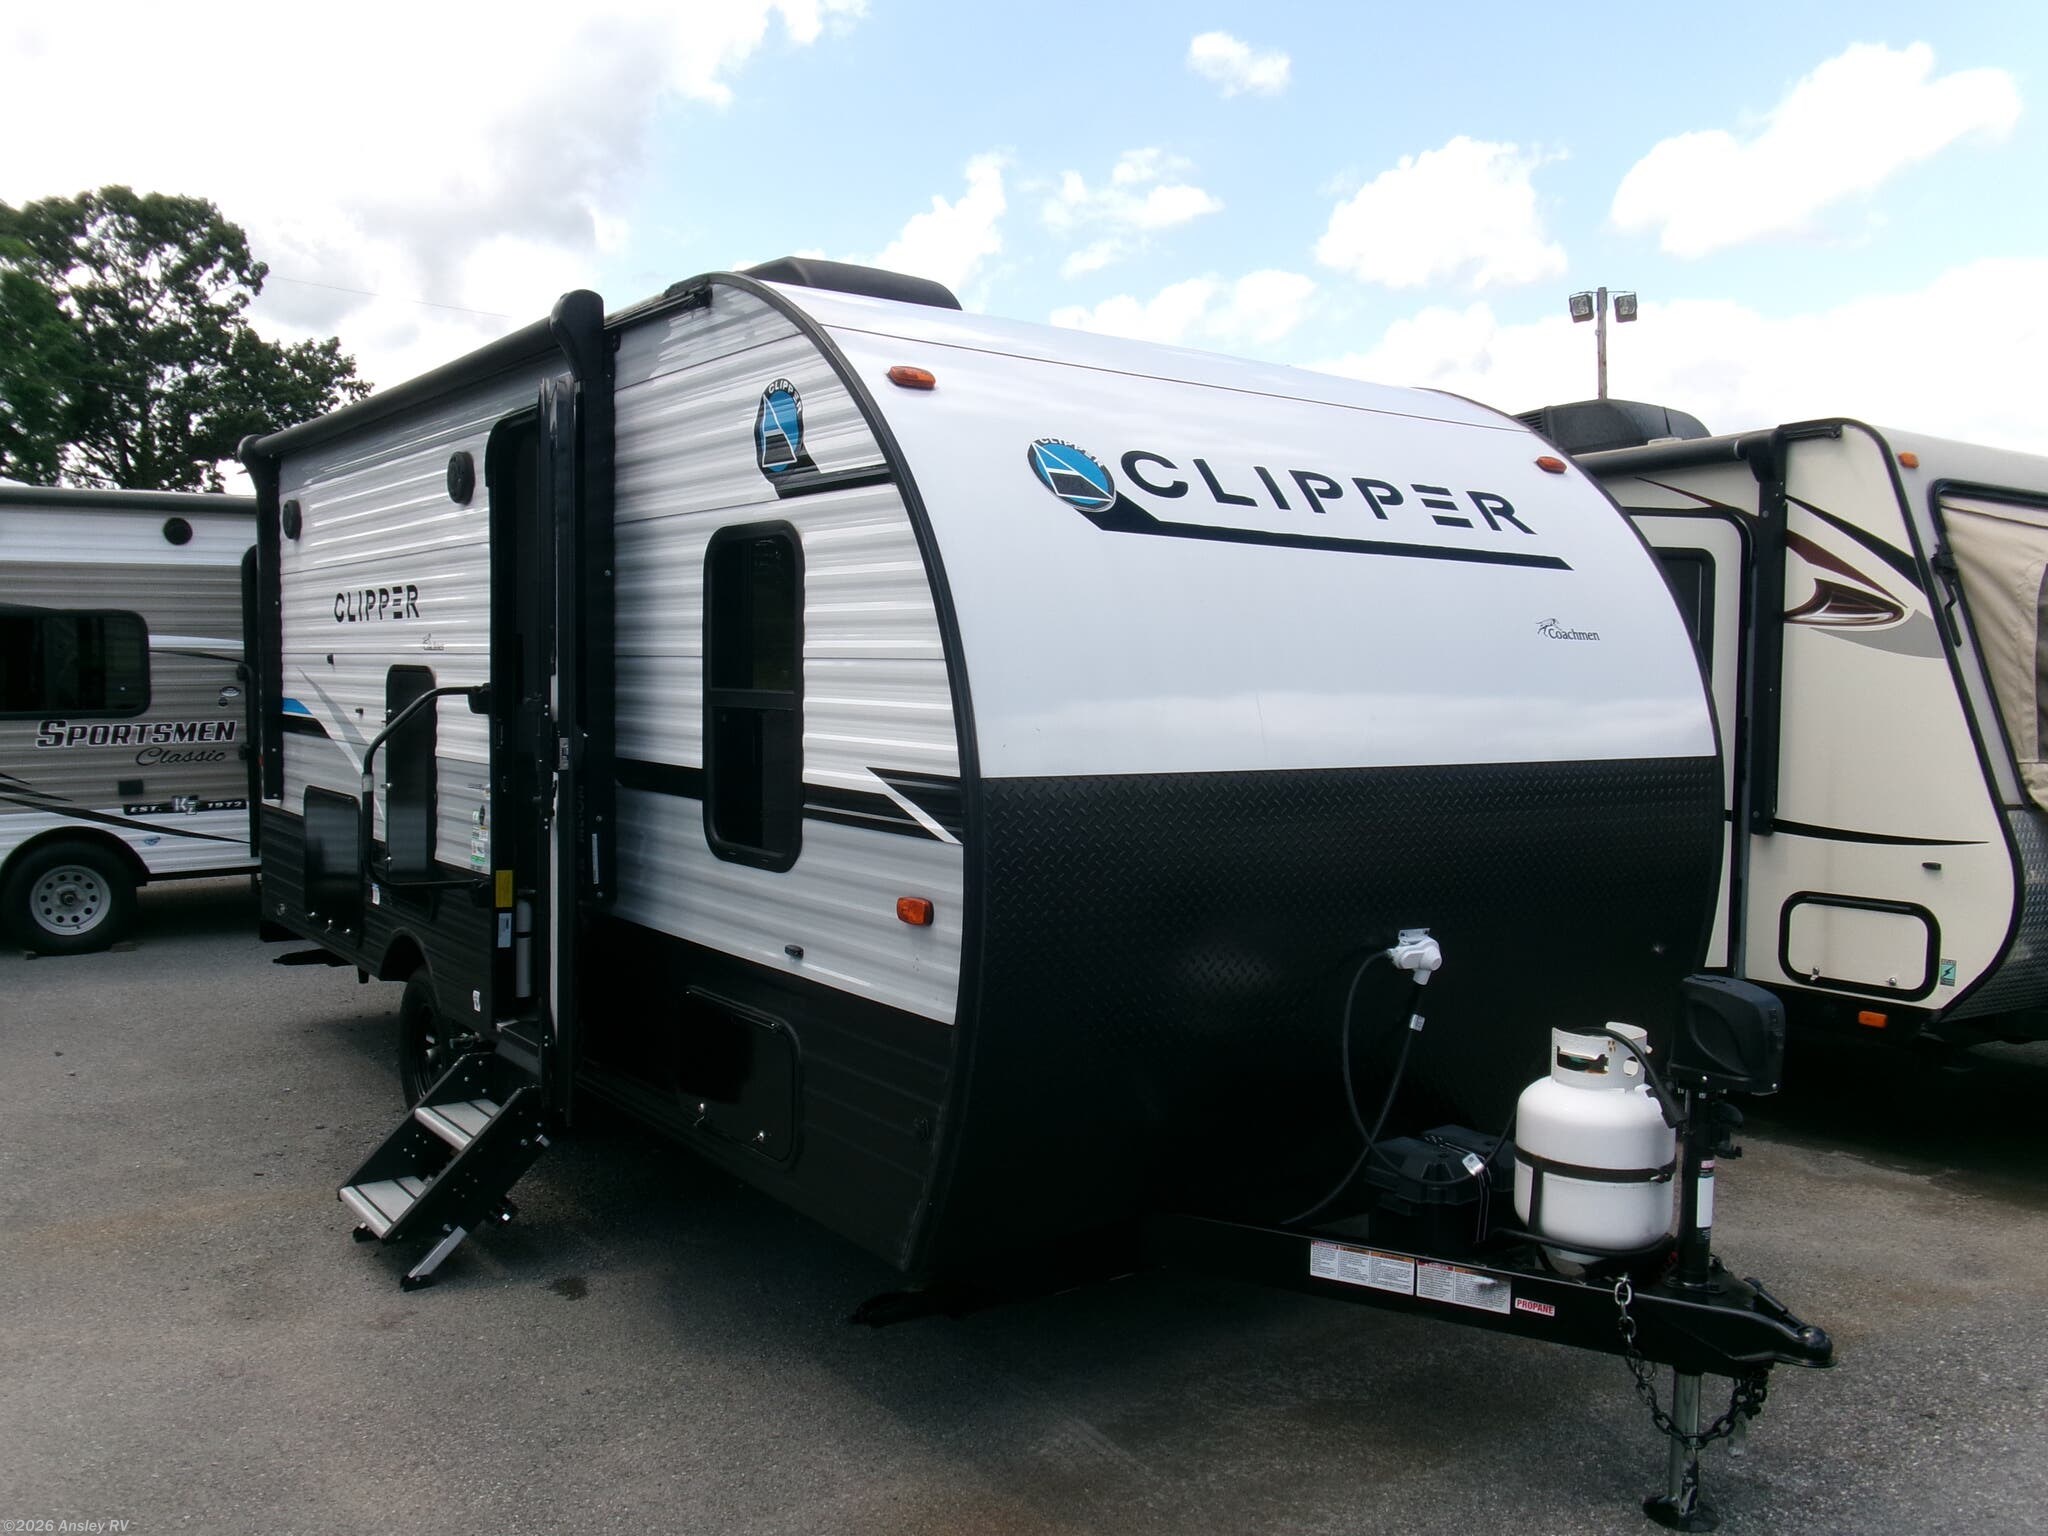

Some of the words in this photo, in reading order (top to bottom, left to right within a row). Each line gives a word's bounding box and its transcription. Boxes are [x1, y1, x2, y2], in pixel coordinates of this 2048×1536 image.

[768, 379, 802, 413] CLIPPER
[1120, 449, 1538, 536] CLIPPER
[333, 584, 420, 623] CLIPPER
[1548, 628, 1601, 641] Coachmen
[135, 747, 226, 766] Classic
[129, 805, 162, 813] EST.
[207, 801, 243, 809] 1972
[1516, 1299, 1554, 1314] PROPANE
